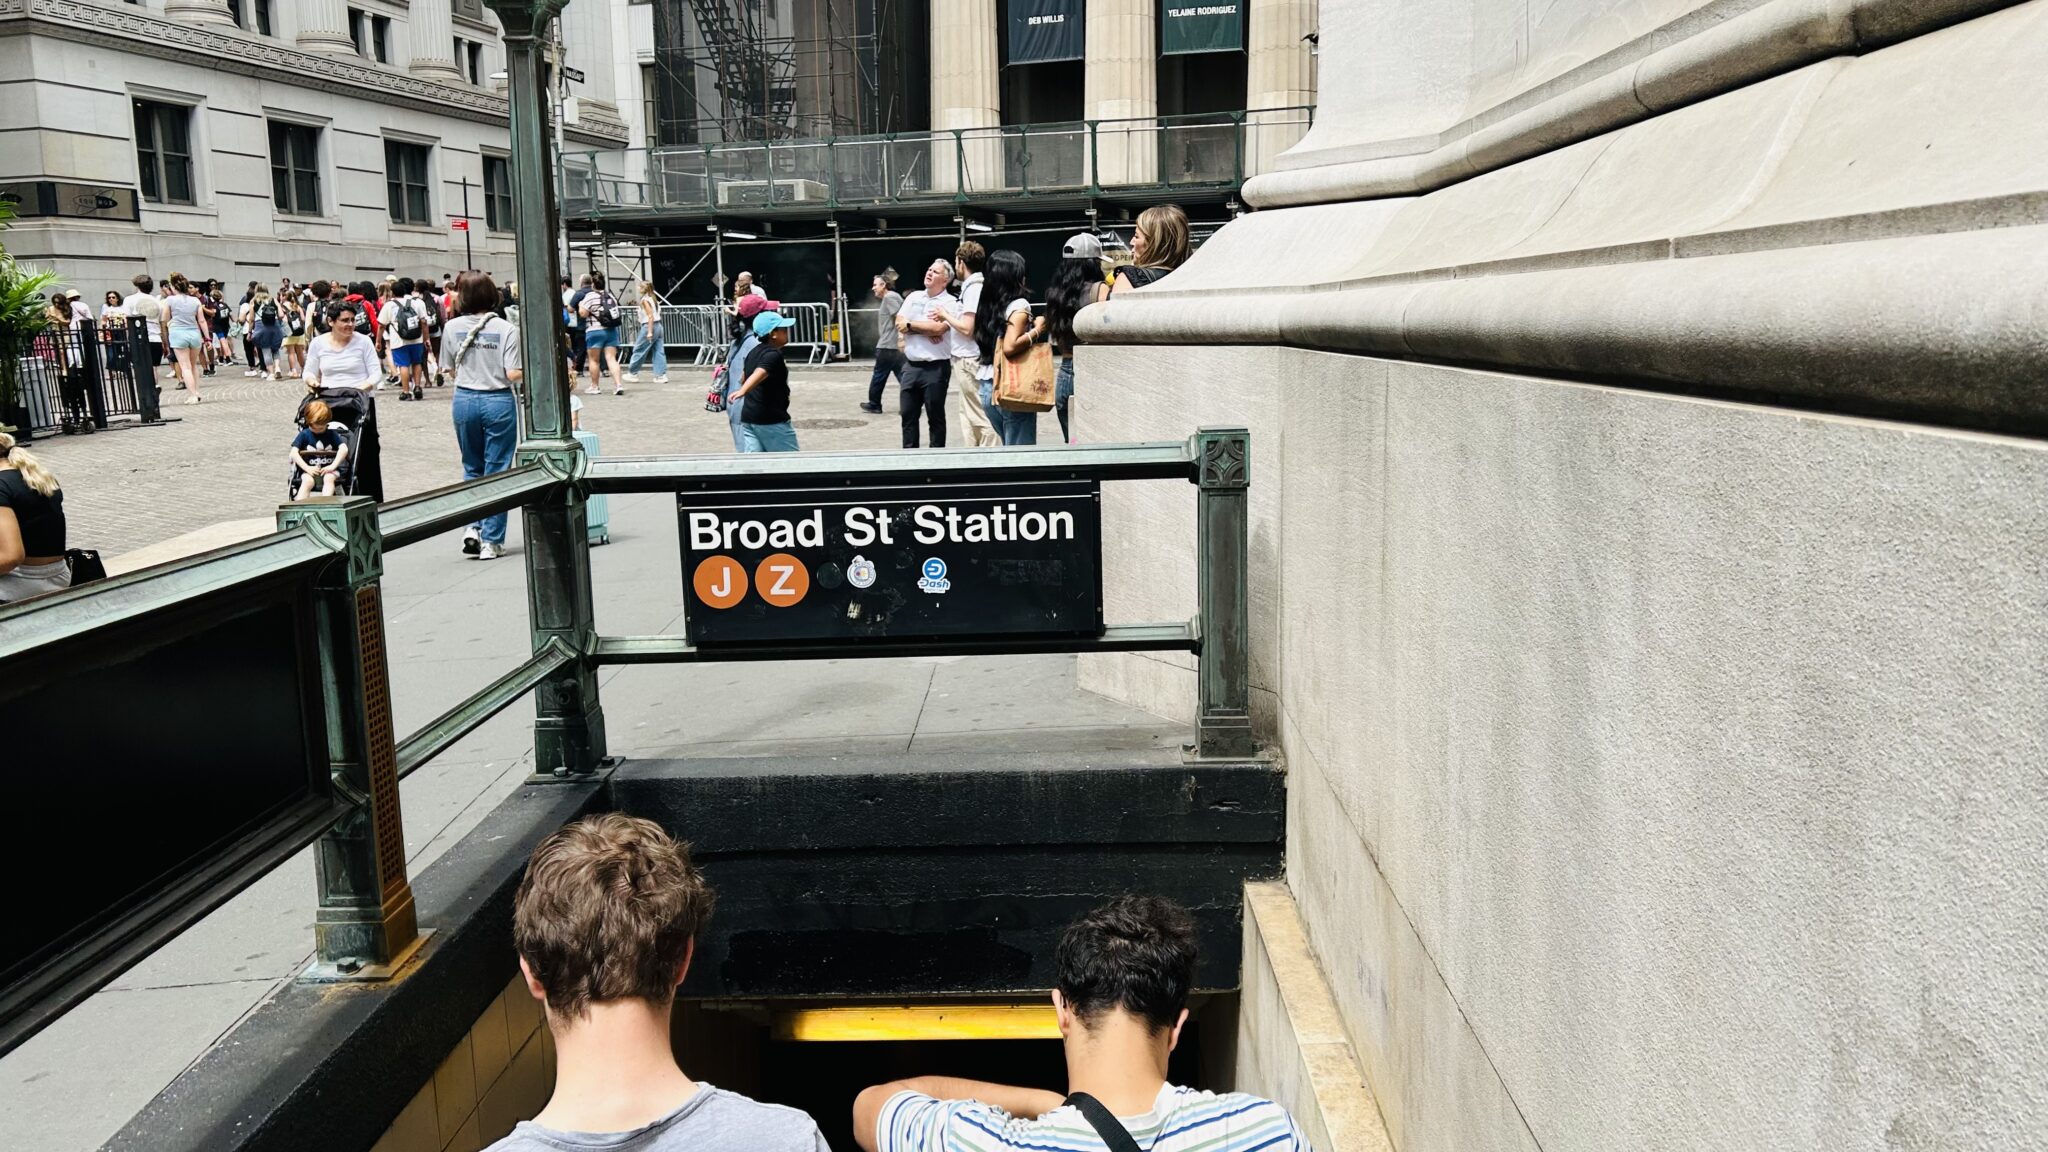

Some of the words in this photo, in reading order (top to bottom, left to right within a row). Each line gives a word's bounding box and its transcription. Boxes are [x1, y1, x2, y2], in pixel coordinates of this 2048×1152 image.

[1028, 16, 1042, 25] DEB
[1042, 14, 1065, 24] WILLIS
[1168, 8, 1196, 17] YELAINE
[1197, 5, 1237, 15] RODRIGUEZ
[688, 509, 824, 551] Broad
[843, 507, 894, 547] St
[912, 503, 1075, 544] Station
[711, 566, 732, 598] J
[769, 565, 796, 596] Z
[919, 578, 949, 588] Dash
